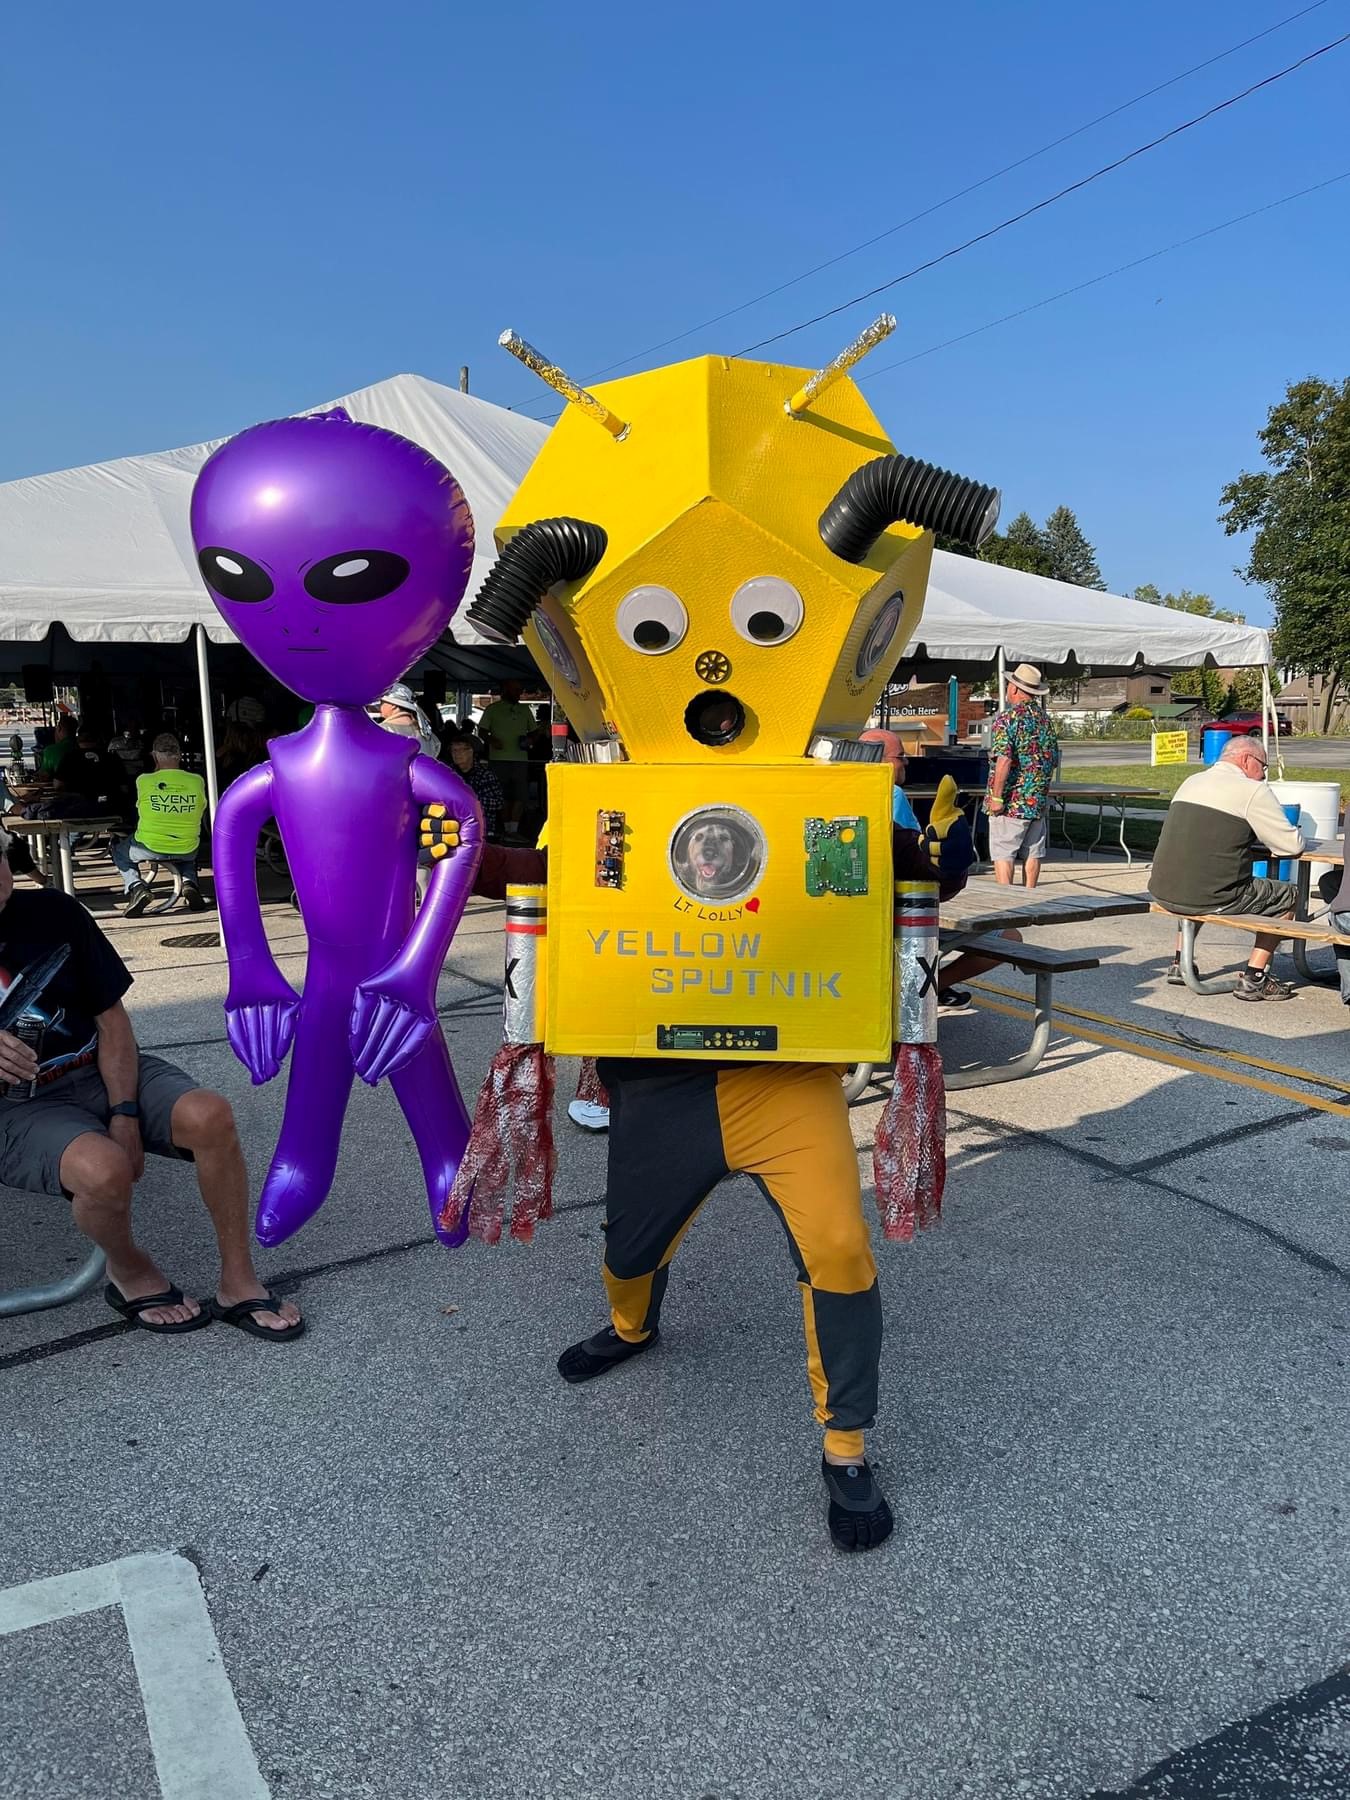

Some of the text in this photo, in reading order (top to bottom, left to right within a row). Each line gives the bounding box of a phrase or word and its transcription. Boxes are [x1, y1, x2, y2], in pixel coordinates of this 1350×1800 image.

[890, 707, 900, 715] Us
[901, 707, 916, 716] Out
[150, 794, 197, 804] EVENT
[151, 803, 196, 813] STAFF
[673, 895, 744, 922] LT. LOLLY
[587, 929, 762, 959] YELLOW
[651, 967, 842, 999] SPUTNIK
[915, 954, 938, 998] X
